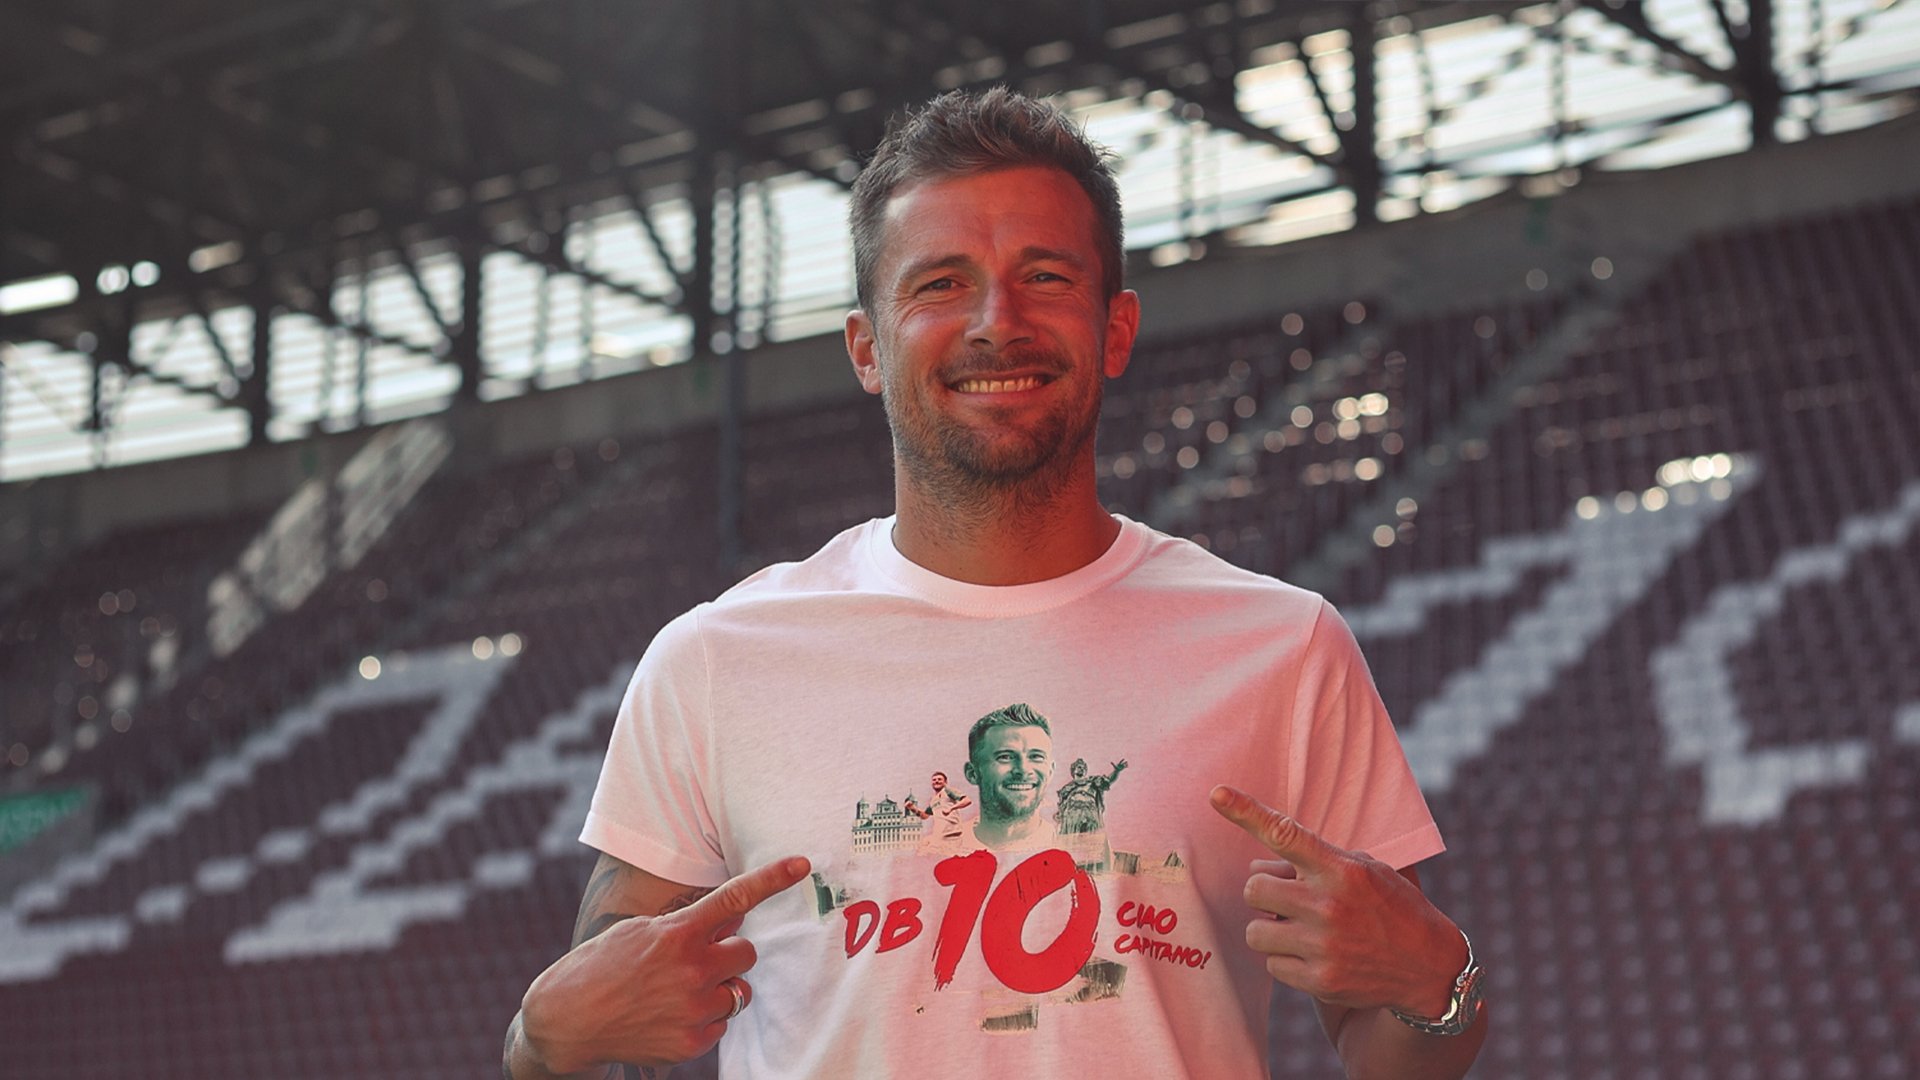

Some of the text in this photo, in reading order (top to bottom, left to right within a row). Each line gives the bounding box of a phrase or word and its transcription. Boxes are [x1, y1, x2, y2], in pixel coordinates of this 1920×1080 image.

[842, 848, 1101, 994] DB 10
[1116, 901, 1177, 935] CIAO
[1114, 934, 1212, 970] CAPITANO!
